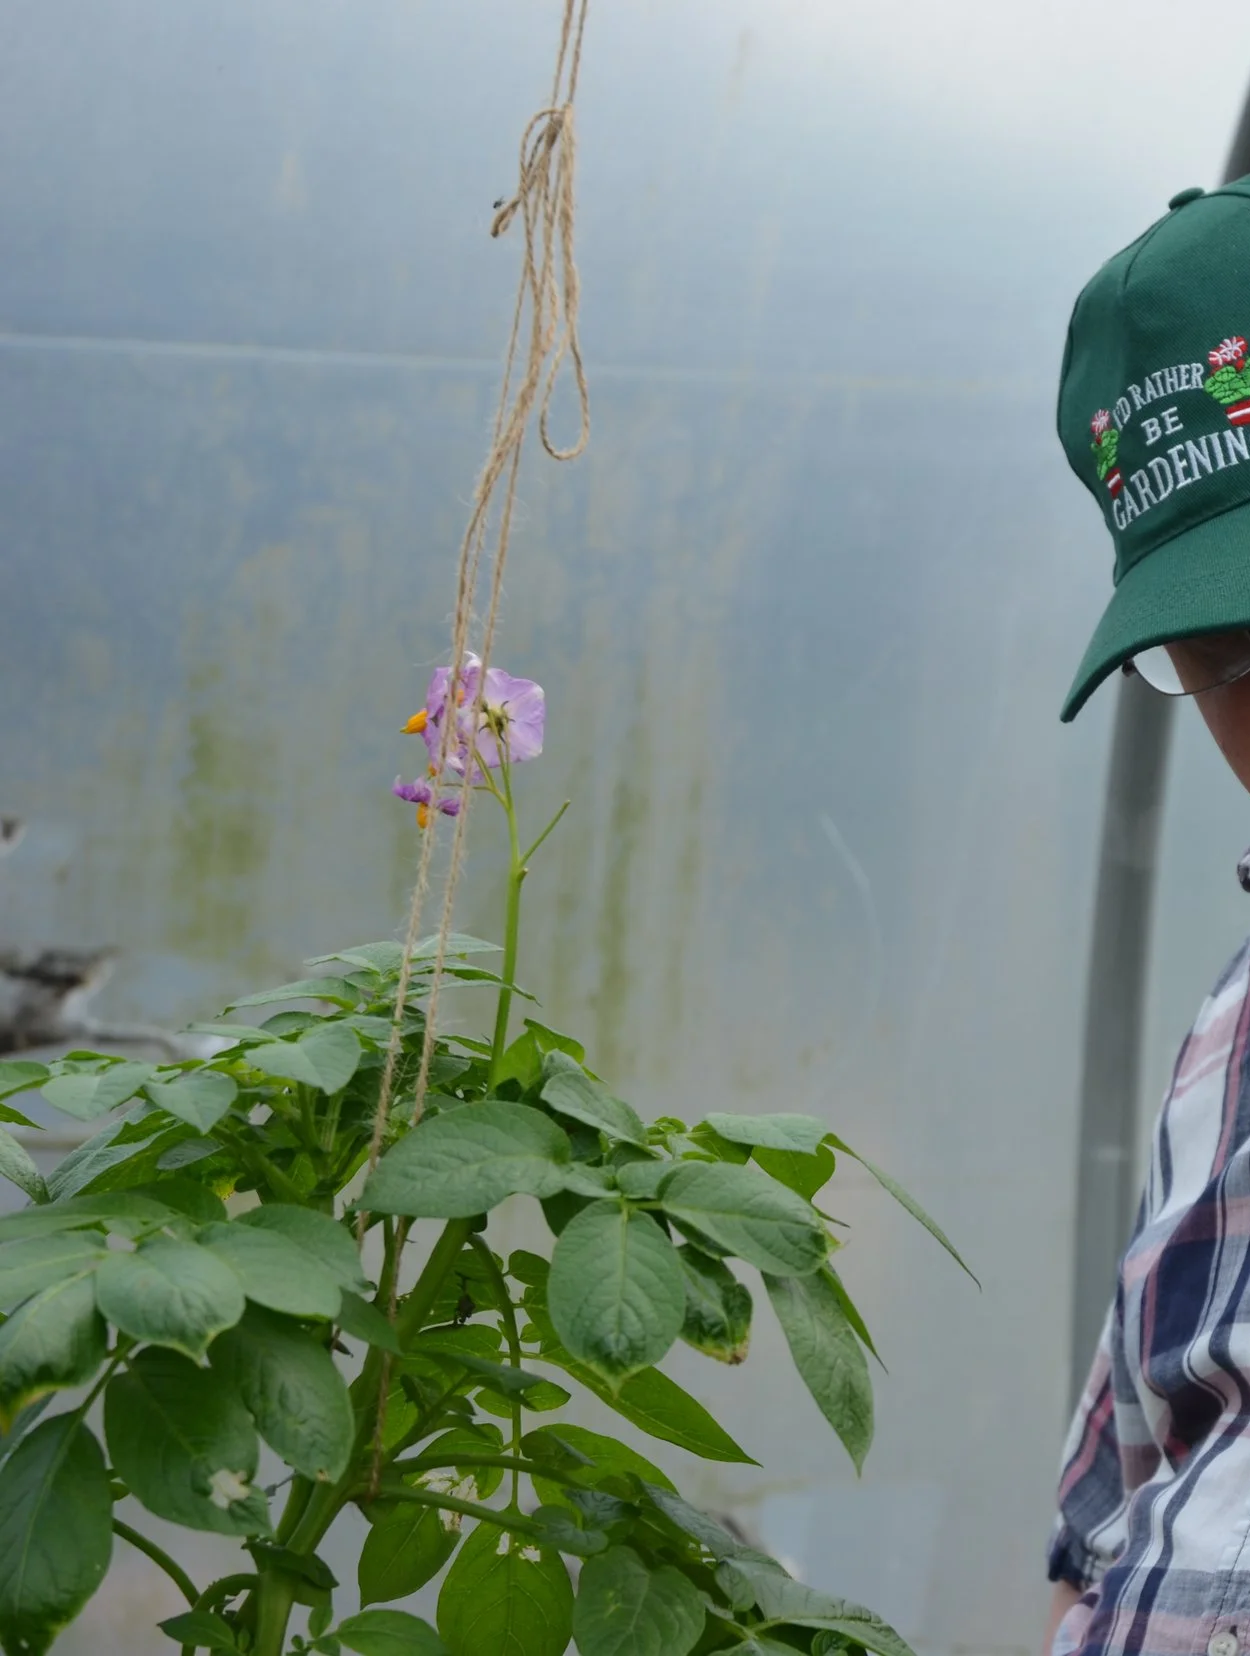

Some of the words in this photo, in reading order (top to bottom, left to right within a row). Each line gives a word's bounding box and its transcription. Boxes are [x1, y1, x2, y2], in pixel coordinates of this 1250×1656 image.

[1112, 396, 1131, 431] I'D
[1127, 362, 1205, 411] RATHER
[1141, 406, 1184, 446] BE
